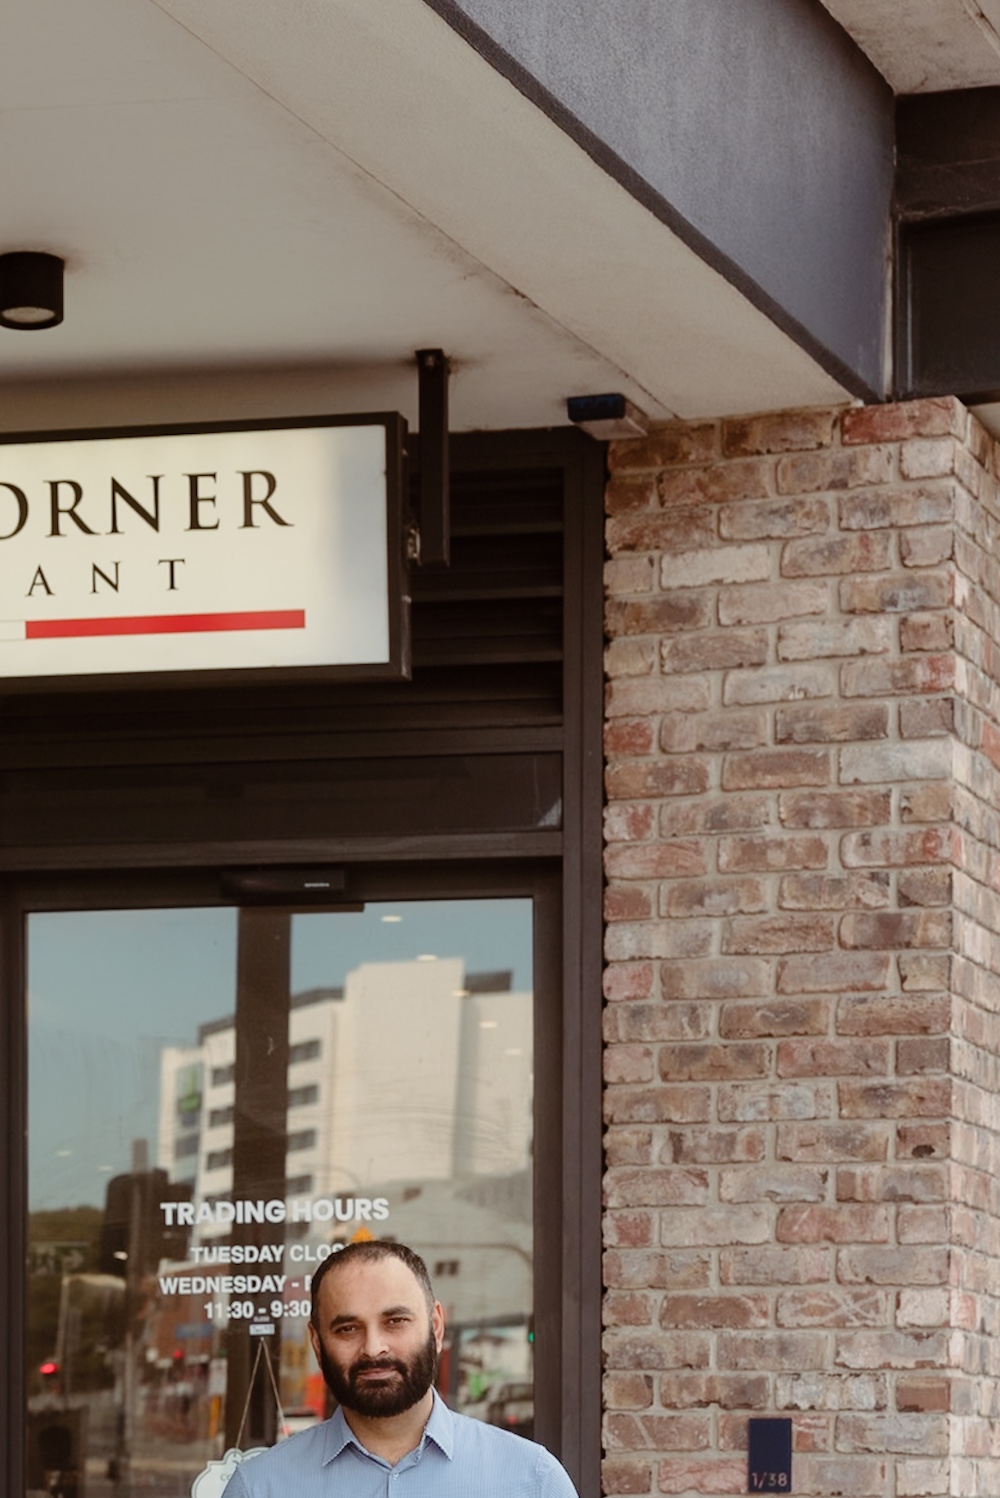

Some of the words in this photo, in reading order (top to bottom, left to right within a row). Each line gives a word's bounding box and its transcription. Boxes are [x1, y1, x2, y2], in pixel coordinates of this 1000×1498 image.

[159, 1199, 286, 1226] TRADING
[291, 1197, 390, 1223] HOURS
[190, 1244, 285, 1264] TUESDAY
[158, 1274, 288, 1295] WEDNESDAY
[203, 1300, 255, 1320] 11:30
[270, 1299, 312, 1319] 9:30
[751, 1472, 788, 1489] 1/38
